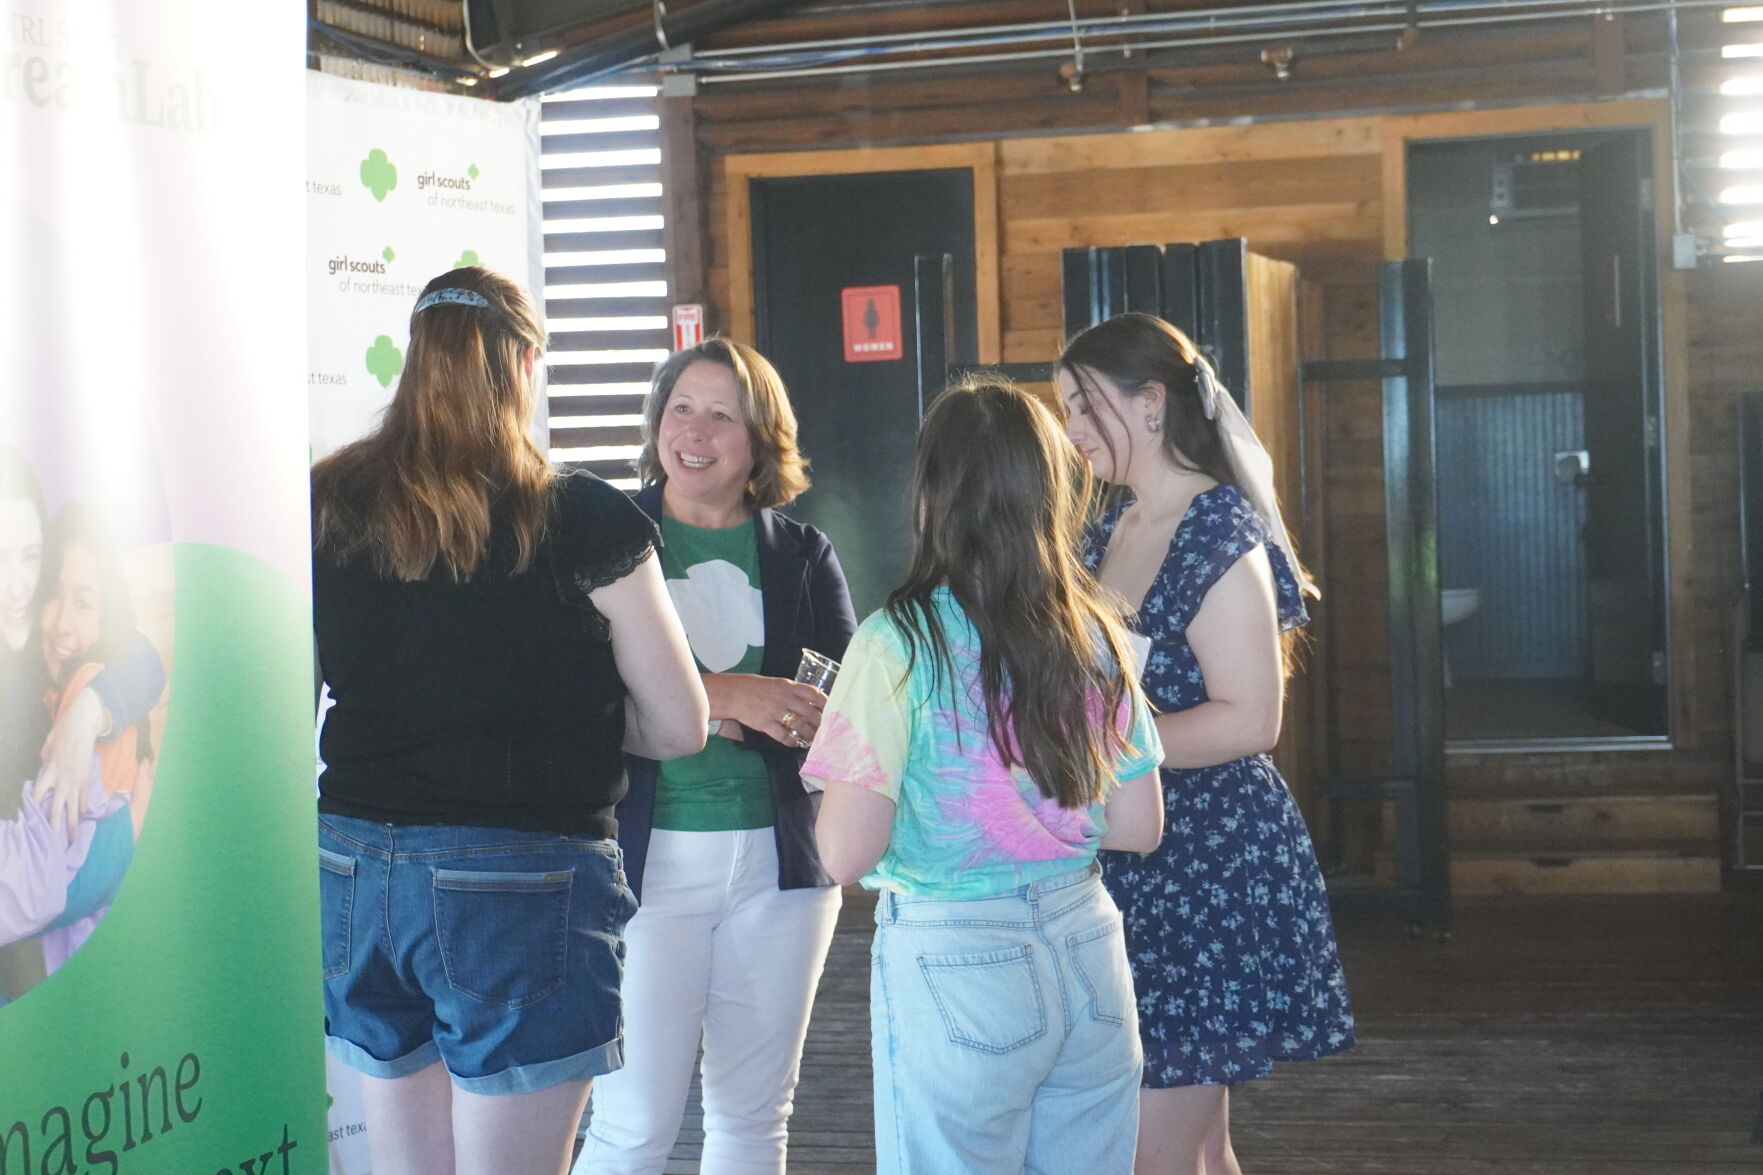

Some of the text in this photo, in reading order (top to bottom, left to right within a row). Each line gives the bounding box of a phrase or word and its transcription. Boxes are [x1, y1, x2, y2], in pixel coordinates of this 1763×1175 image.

[313, 180, 342, 196] texas
[417, 171, 471, 191] girl scouts
[427, 192, 515, 215] of northeast texas
[329, 255, 386, 275] girl scouts
[339, 276, 351, 292] of
[354, 279, 405, 296] northeast
[853, 342, 893, 352] WOMEN
[318, 373, 347, 385] texas
